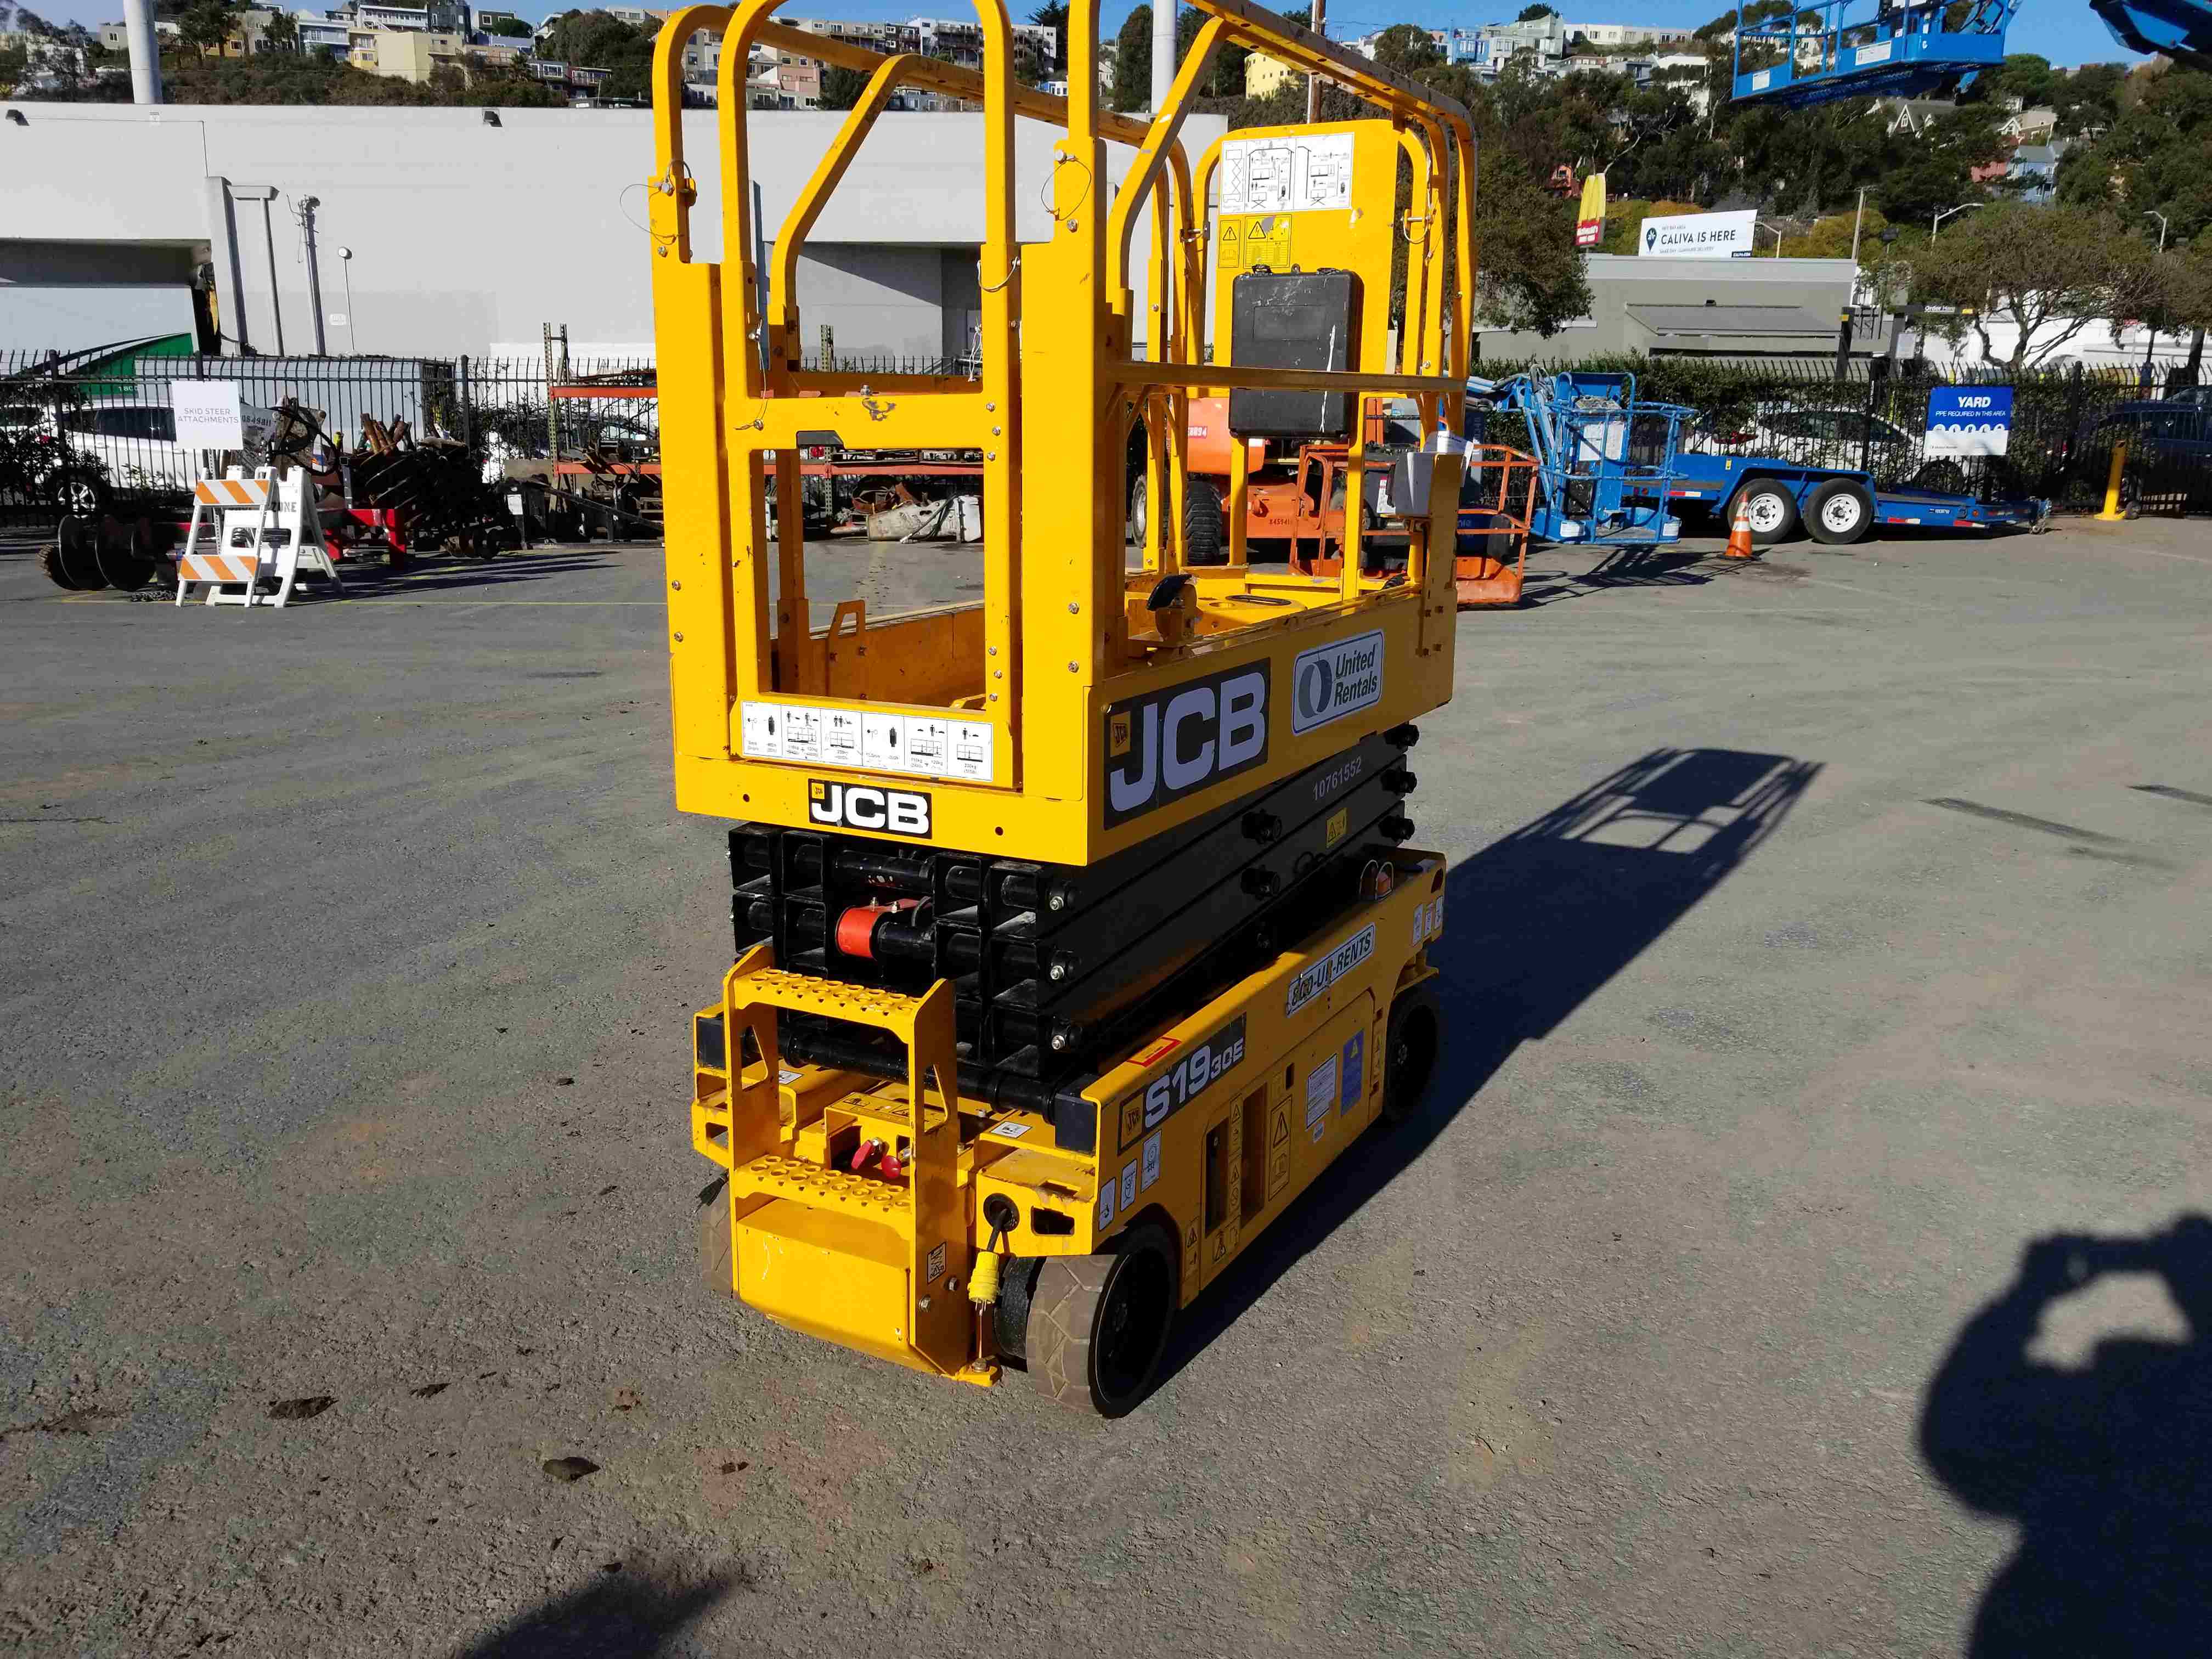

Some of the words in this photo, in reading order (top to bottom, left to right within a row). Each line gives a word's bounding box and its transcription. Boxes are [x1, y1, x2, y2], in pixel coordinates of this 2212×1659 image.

[1661, 232, 1694, 245] CALIVA
[1697, 232, 1706, 243] IS
[1710, 230, 1736, 242] HERE
[1958, 397, 1991, 408] YARD
[1335, 644, 1377, 678] United
[1334, 671, 1378, 707] Rentals
[1109, 672, 1266, 812] JCB
[1313, 756, 1361, 800] 10761552
[811, 785, 929, 834] JCB
